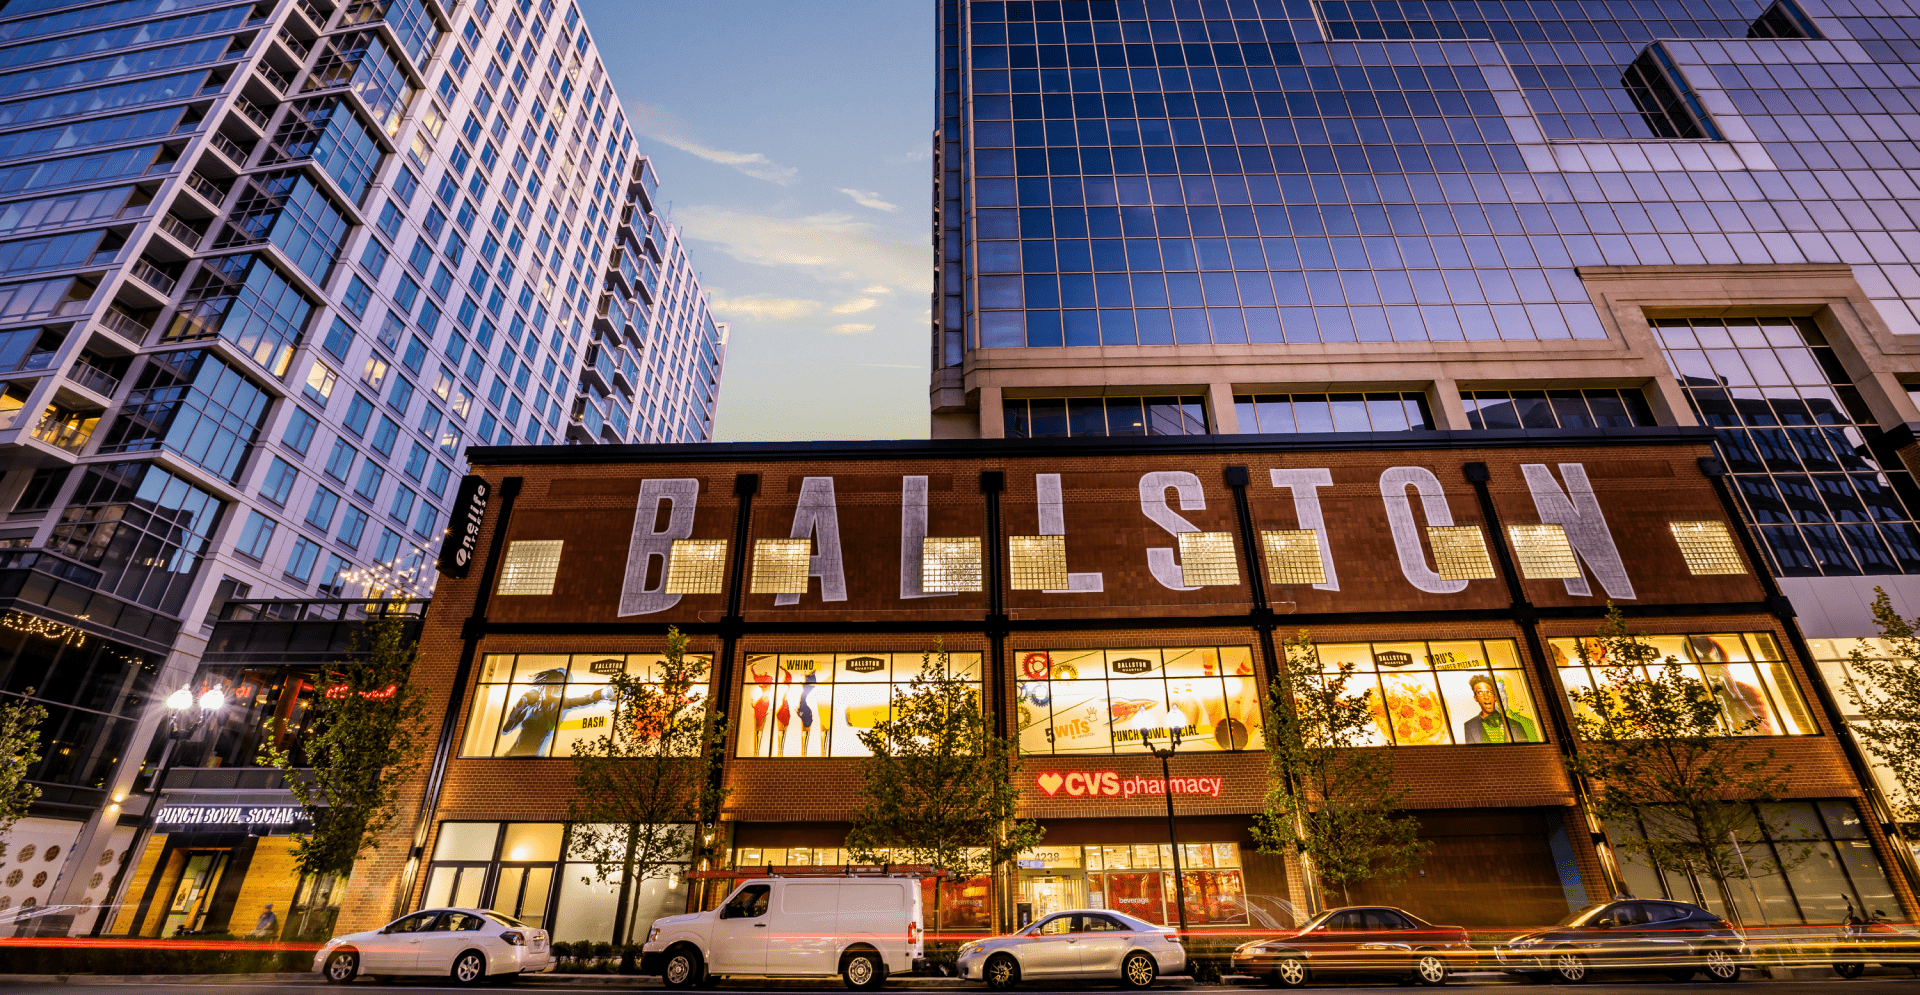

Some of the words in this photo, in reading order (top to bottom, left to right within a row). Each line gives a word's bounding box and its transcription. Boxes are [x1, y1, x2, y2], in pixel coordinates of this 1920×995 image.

[617, 461, 1637, 617] BALLSTON
[1378, 654, 1408, 662] BALLSTON
[594, 662, 624, 670] BALLSTON
[787, 660, 814, 671] WHINO
[1117, 661, 1147, 669] BALLSTON
[1457, 660, 1472, 668] PIZZA
[582, 716, 605, 729] BASH
[1112, 729, 1139, 742] PUNCH
[1145, 727, 1168, 740] OWL
[1065, 772, 1120, 796] CVS
[1123, 775, 1221, 799] pharmacy
[156, 807, 204, 824] PUNCH
[203, 807, 242, 824] BOWL
[246, 807, 294, 824] SOCIAL
[1034, 852, 1060, 863] 4238
[1118, 896, 1150, 905] beverage
